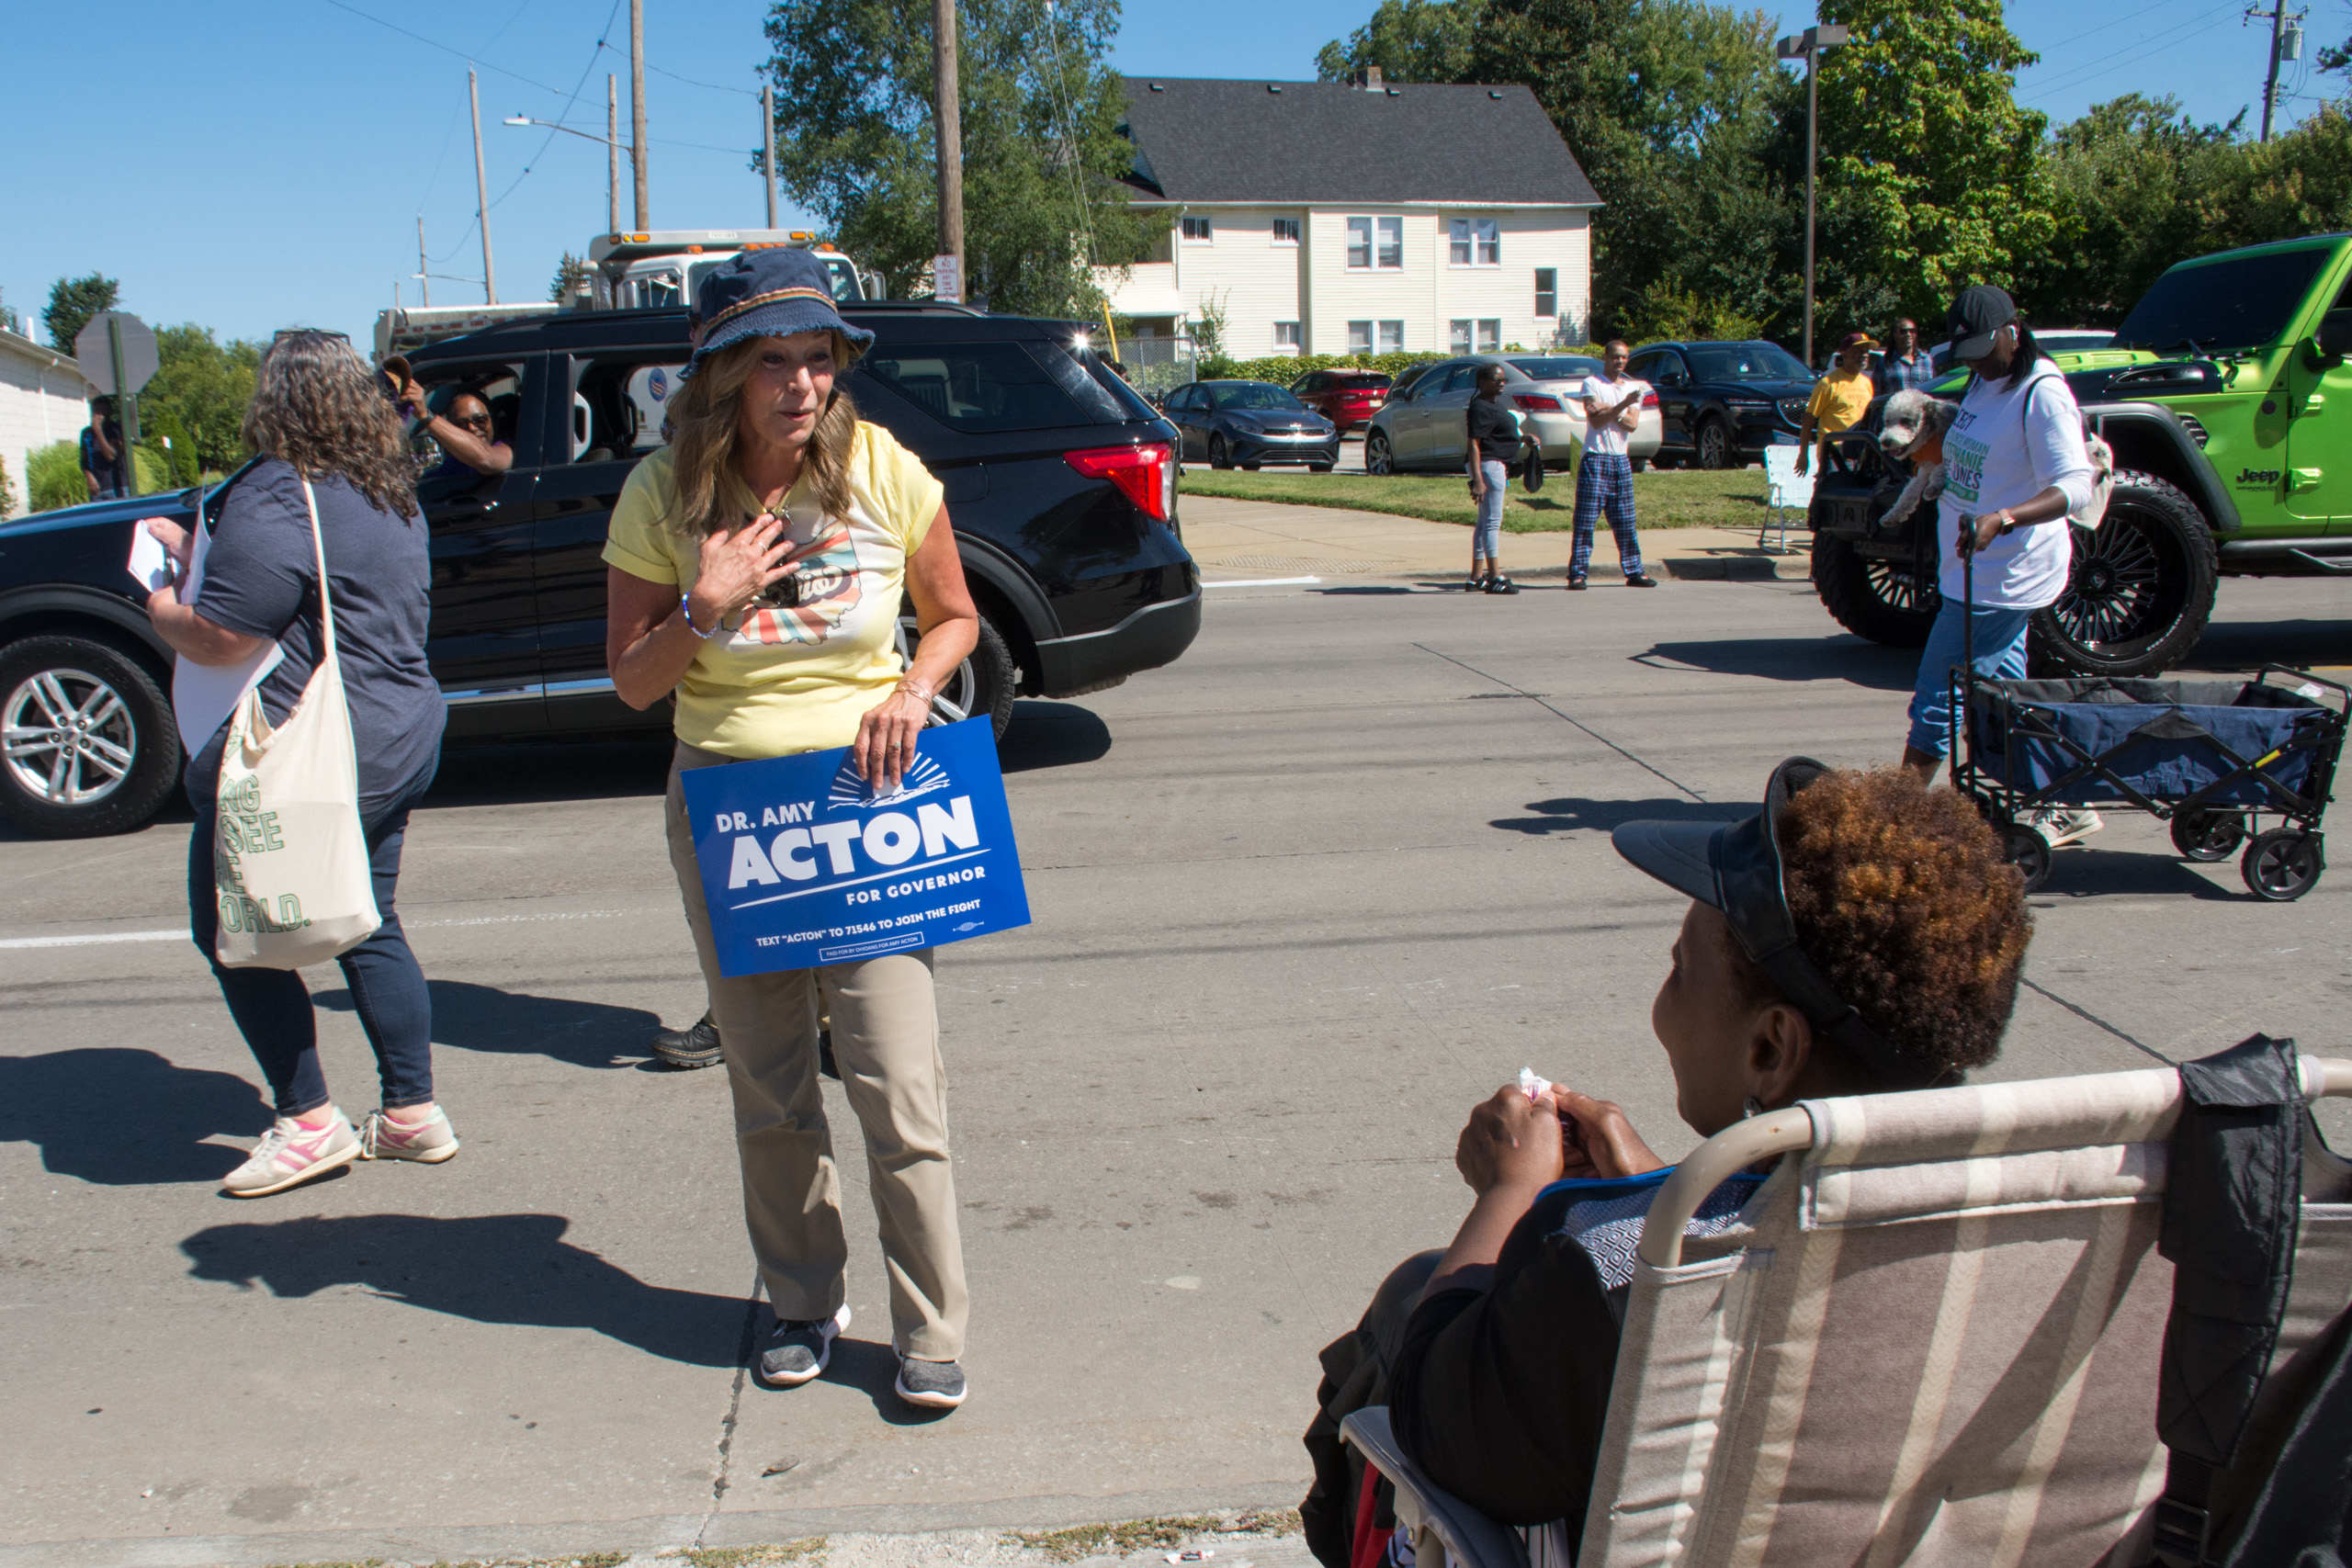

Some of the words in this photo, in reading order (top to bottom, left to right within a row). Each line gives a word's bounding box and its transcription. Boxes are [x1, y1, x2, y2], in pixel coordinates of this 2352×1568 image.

[2236, 467, 2279, 484] Jeep
[220, 811, 285, 853] SEE
[716, 812, 756, 833] DR.
[762, 801, 815, 827] AMY
[729, 795, 979, 889] ACTON
[846, 889, 881, 906] FOR
[887, 866, 987, 898] GOVERNOR
[756, 935, 780, 947] TEXT
[829, 928, 844, 938] TO
[845, 922, 876, 936] 71546
[877, 919, 894, 930] TO
[895, 912, 924, 928] JOIN
[925, 907, 947, 919] THE
[948, 899, 981, 915] FIGHT
[855, 943, 878, 953] OHIOANS
[900, 936, 918, 944] ACTON
